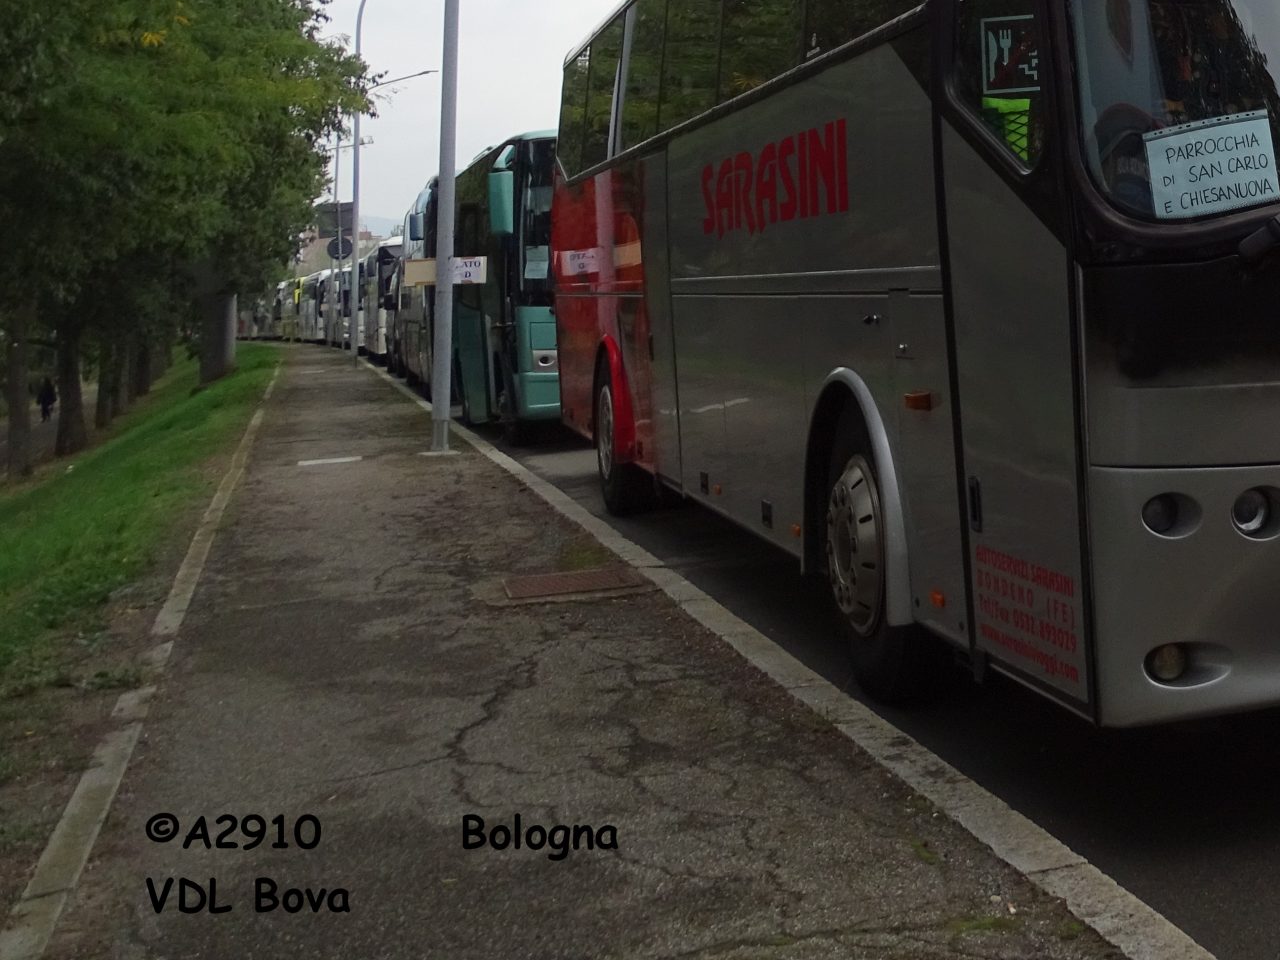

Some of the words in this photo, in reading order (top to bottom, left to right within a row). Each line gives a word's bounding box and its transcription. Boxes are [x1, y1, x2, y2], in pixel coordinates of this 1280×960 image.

[1165, 131, 1260, 164] PARROCCHIA
[701, 118, 849, 239] SARASINI
[1162, 174, 1175, 187] DI
[1188, 161, 1223, 183] SAN
[1227, 153, 1269, 173] CARLO
[1164, 200, 1173, 214] E
[1180, 178, 1274, 210] CHIESANUOVA
[1032, 563, 1075, 598] SARASINI
[978, 570, 1034, 608] BONDENO
[1047, 598, 1075, 631] (FE)
